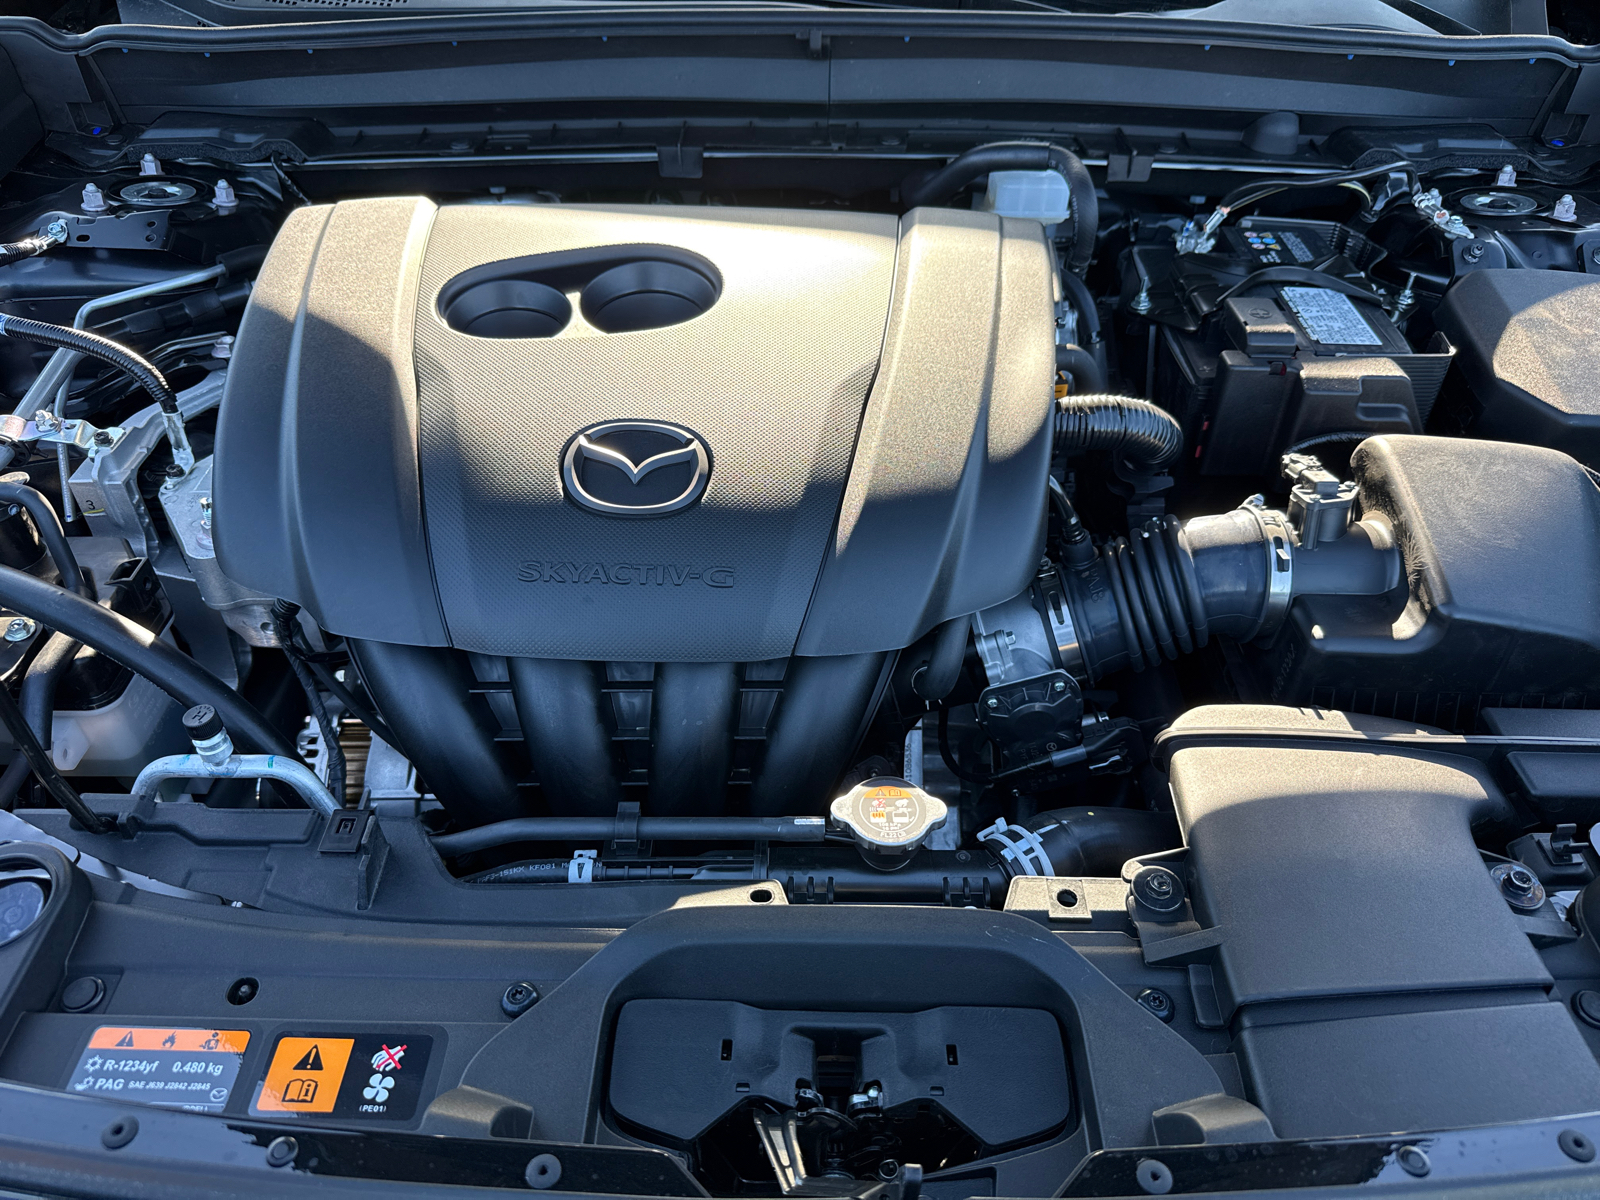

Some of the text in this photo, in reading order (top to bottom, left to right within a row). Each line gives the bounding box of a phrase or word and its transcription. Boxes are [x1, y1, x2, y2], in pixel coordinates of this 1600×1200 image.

[86, 500, 96, 510] 3
[518, 560, 735, 589] SKYACTIV-G
[191, 710, 208, 721] H
[102, 1059, 224, 1076] R-1234yf 0.480 kg
[94, 1078, 125, 1090] PAG
[128, 1080, 146, 1089] SAE
[146, 1081, 165, 1090] J639
